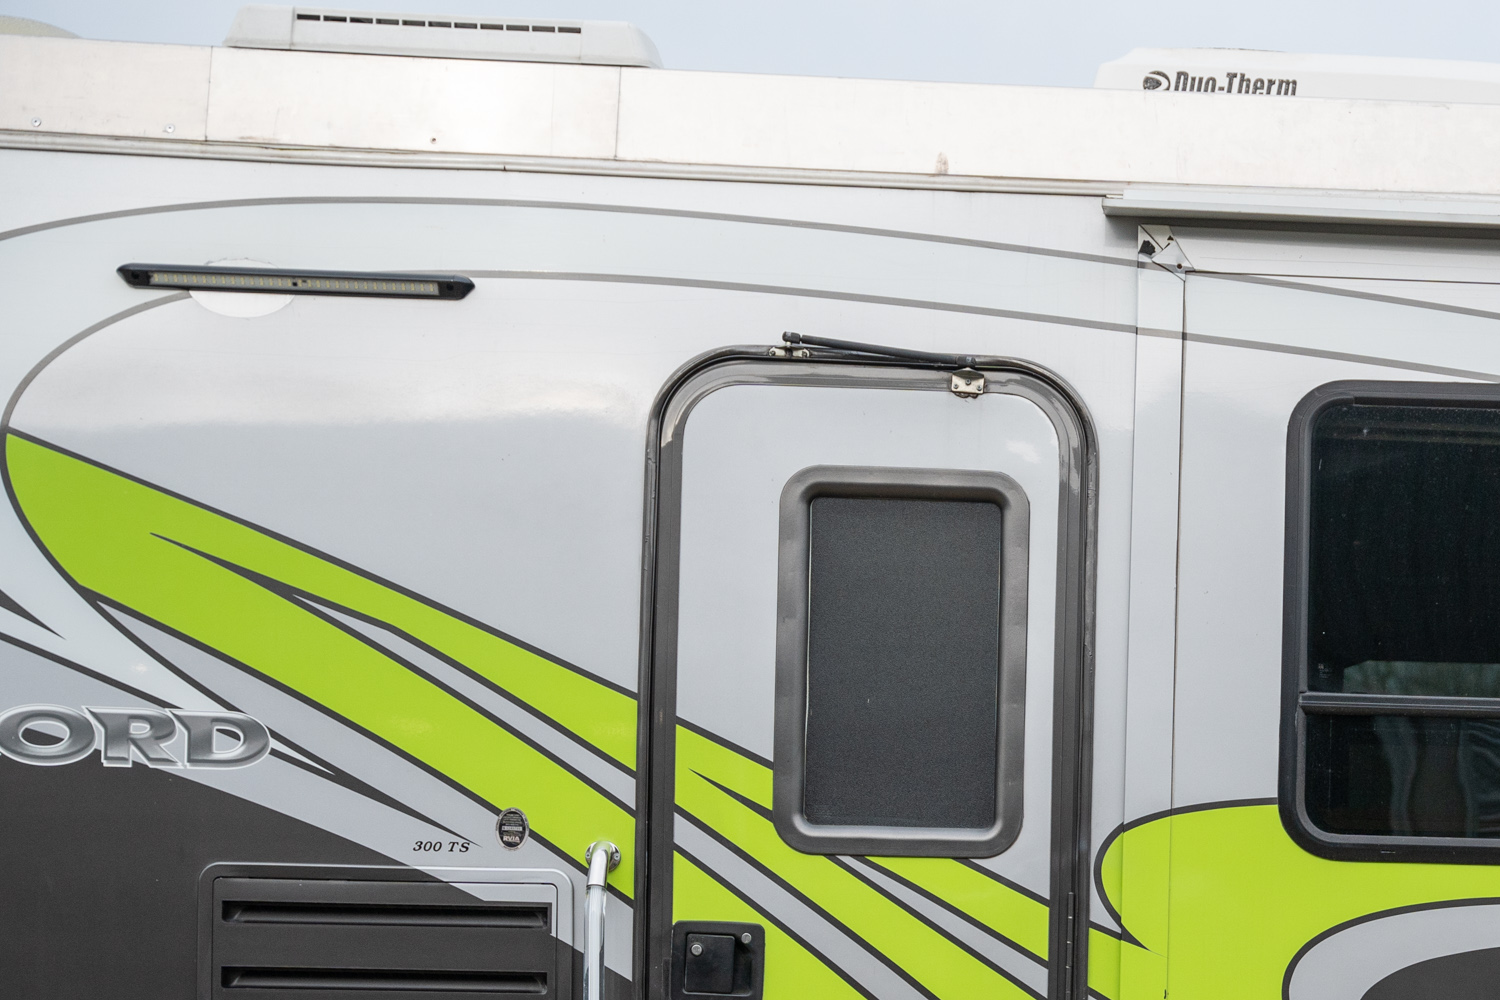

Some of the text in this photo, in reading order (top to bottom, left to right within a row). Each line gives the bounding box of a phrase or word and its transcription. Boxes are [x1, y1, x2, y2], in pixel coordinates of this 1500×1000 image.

[0, 704, 271, 769] ORD
[412, 841, 470, 853] 300 TS
